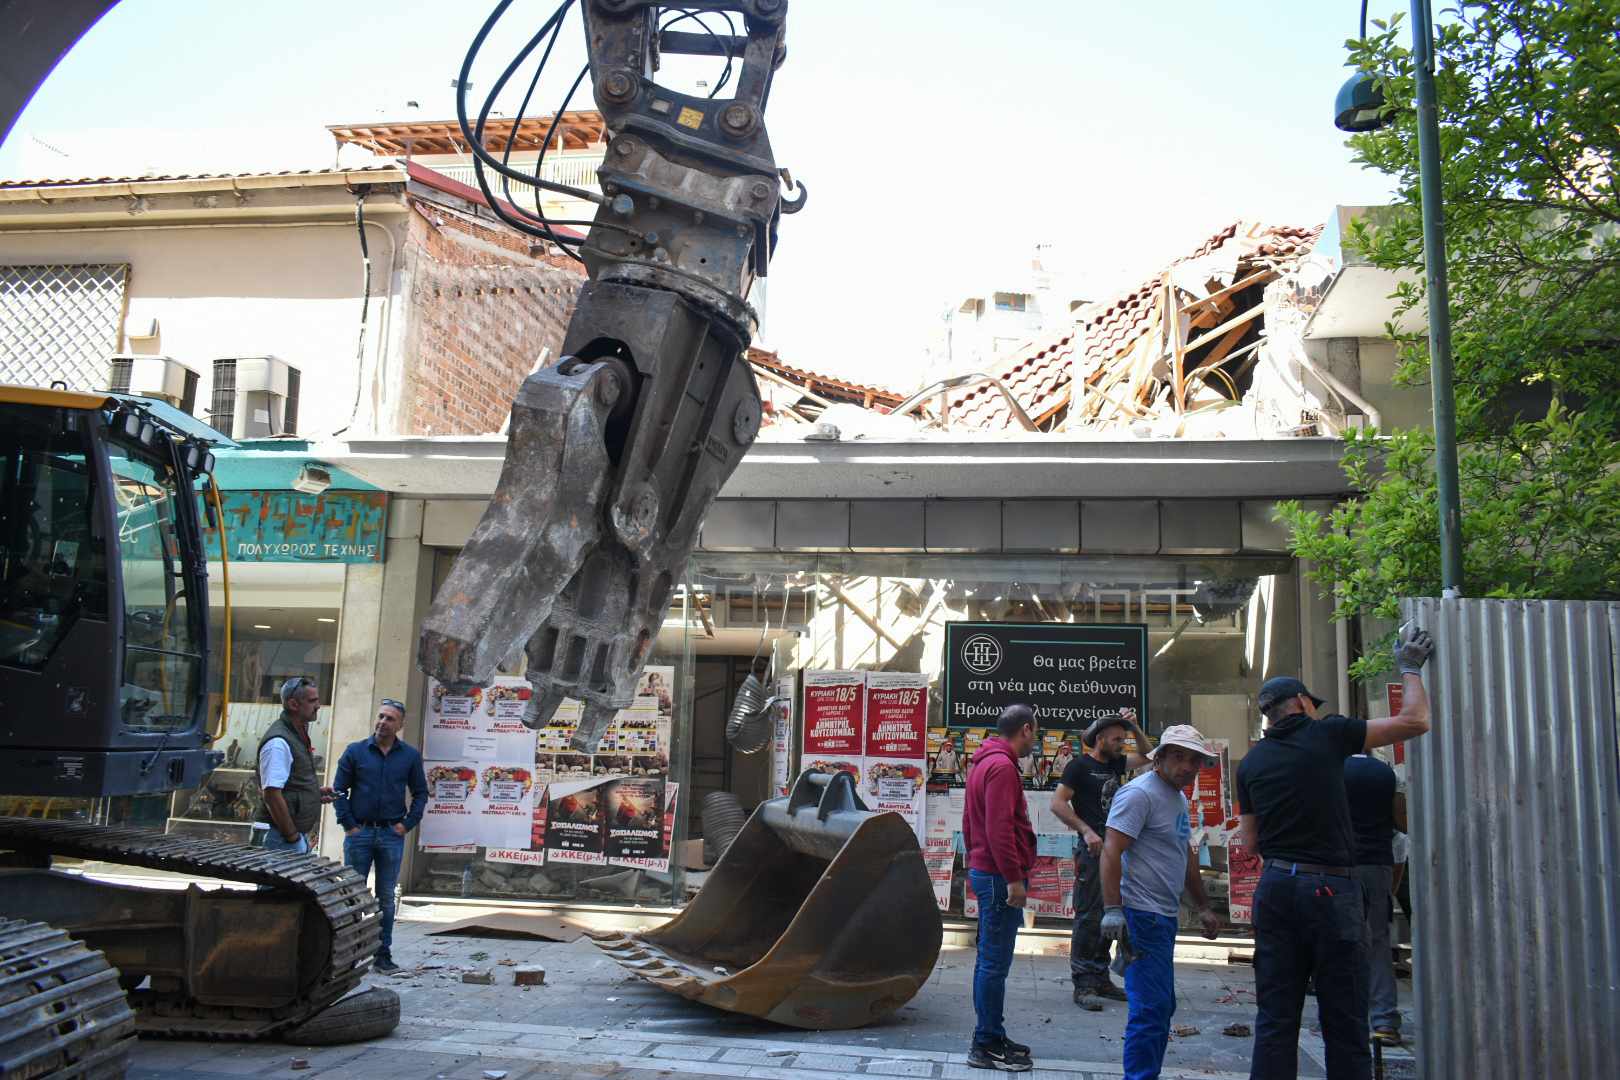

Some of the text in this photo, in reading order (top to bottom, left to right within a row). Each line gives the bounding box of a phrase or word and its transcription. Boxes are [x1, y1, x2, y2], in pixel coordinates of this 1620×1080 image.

[237, 543, 376, 557] ΠΟΛΥΧΩΡΟΣ ΤΕΧΝΗΣ
[1033, 654, 1137, 672] Θα μας βρείτε
[835, 687, 857, 702] 18/5
[967, 678, 1137, 698] στη νέα μας διεύθυνση
[872, 690, 921, 705] ΚΥΡΙΑΚΗ 18/5
[1032, 703, 1116, 721] λυτεχνείου
[877, 723, 913, 733] ΔΗΜΗΤΡΗΣ
[872, 731, 918, 741] ΚΟΥΤΣΟΥΜΠΑΣ
